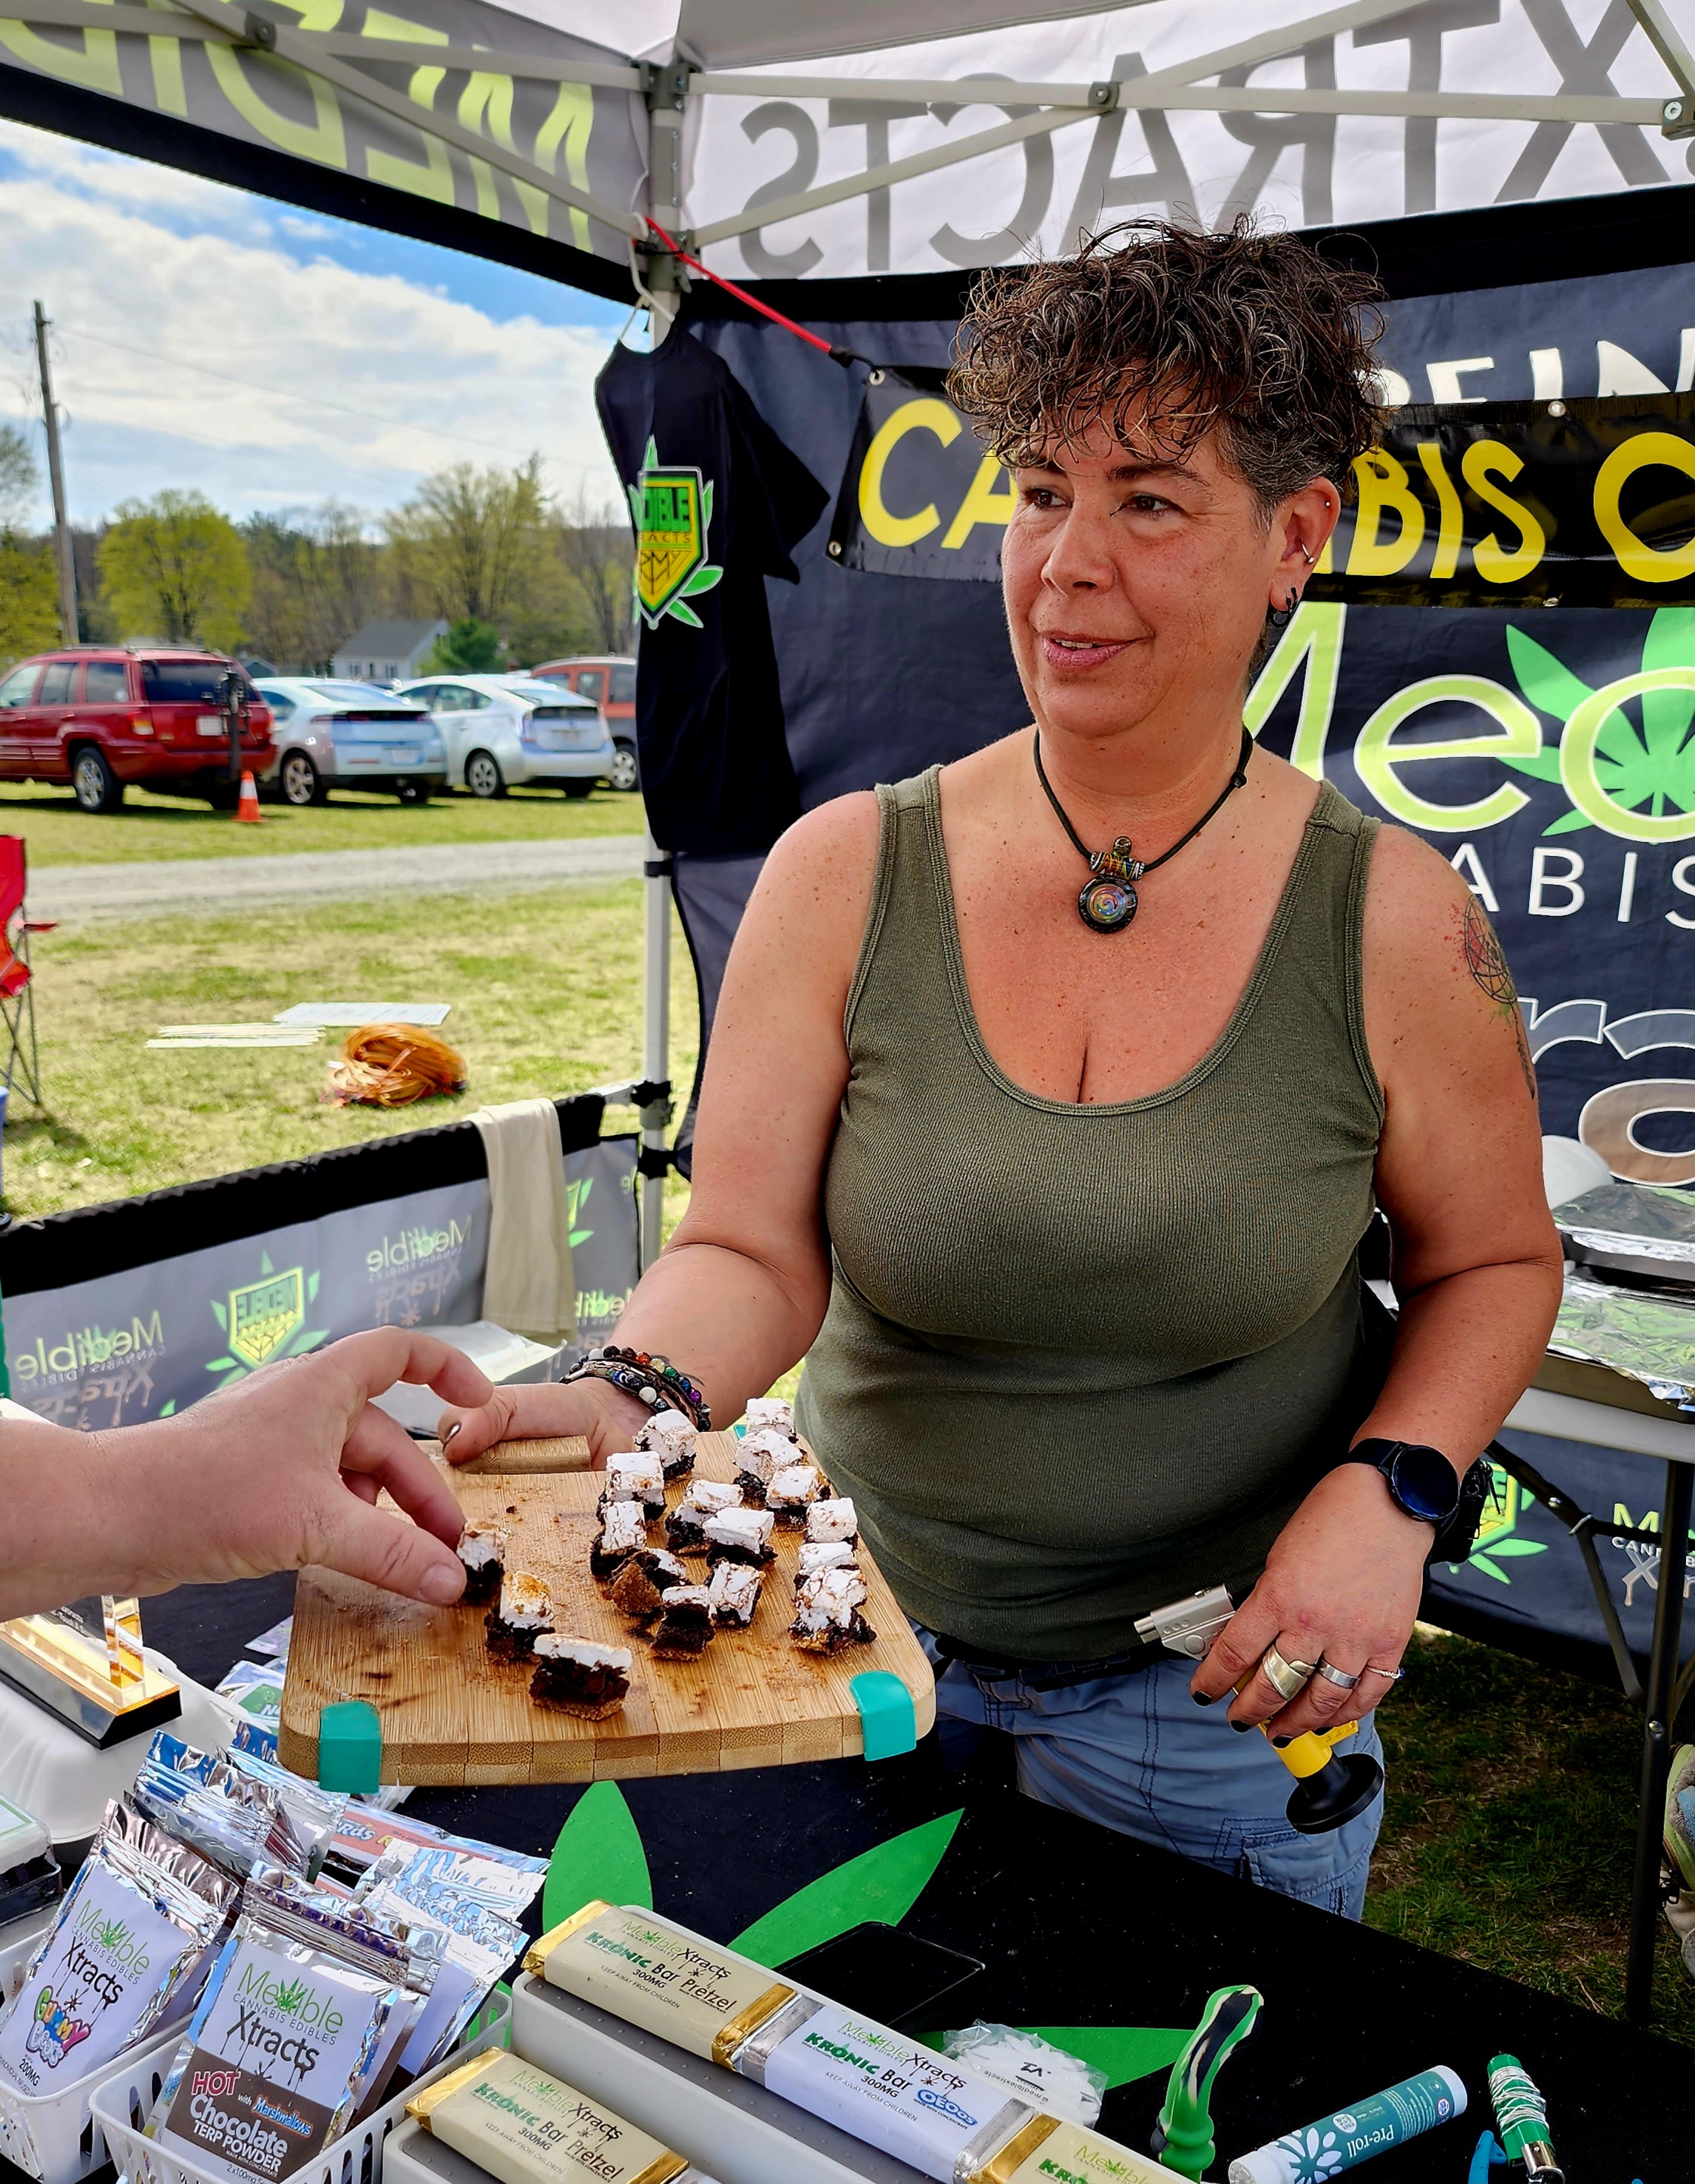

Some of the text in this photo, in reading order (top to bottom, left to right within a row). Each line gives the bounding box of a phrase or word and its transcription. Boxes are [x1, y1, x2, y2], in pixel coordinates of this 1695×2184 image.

[72, 1925, 140, 1985] CANNABIS EDIBLES
[75, 1899, 149, 1975] Medible
[61, 1936, 124, 2004] Xtracts
[585, 1931, 652, 1969] KRONIC
[651, 1963, 680, 1982] Bar
[680, 1978, 737, 2010] Pretzel
[632, 1969, 667, 1989] 300MG
[676, 1947, 731, 1979] Xtracts
[237, 1962, 343, 2034] Medible
[601, 1965, 680, 2009] KEEP AWAY FROM CHILDREN
[226, 2004, 320, 2072] Xtracts
[233, 1993, 336, 2045] CANNABIS EDIBLES
[804, 2032, 881, 2075] KRONIC
[880, 2069, 913, 2090] Bar
[838, 2029, 903, 2063] CANNABIS EDIBLES
[19, 2058, 40, 2086] 200MG
[192, 2071, 241, 2096] HOT
[861, 2075, 900, 2098] 300MG
[904, 2052, 967, 2089] Xtracts
[237, 2094, 312, 2136] with Marshmallows
[825, 2072, 918, 2122] KEEP AWAY FROM CHILDREN
[913, 2098, 926, 2107] MADE
[938, 2112, 968, 2129] CONCENTRATE
[190, 2093, 288, 2158] Chocolate
[474, 2082, 541, 2126] KRONIC
[538, 2120, 569, 2143] Bar
[566, 2139, 625, 2179] Pretzel
[518, 2127, 552, 2151] 300MG
[568, 2102, 623, 2140] Xtracts
[1347, 2124, 1395, 2159] Pre-roll
[193, 2120, 282, 2173] TERP POWDER
[226, 2149, 278, 2178] MADE WITH CONCENTRATE
[485, 2122, 563, 2174] KEEP AWAY FROM CHILDREN
